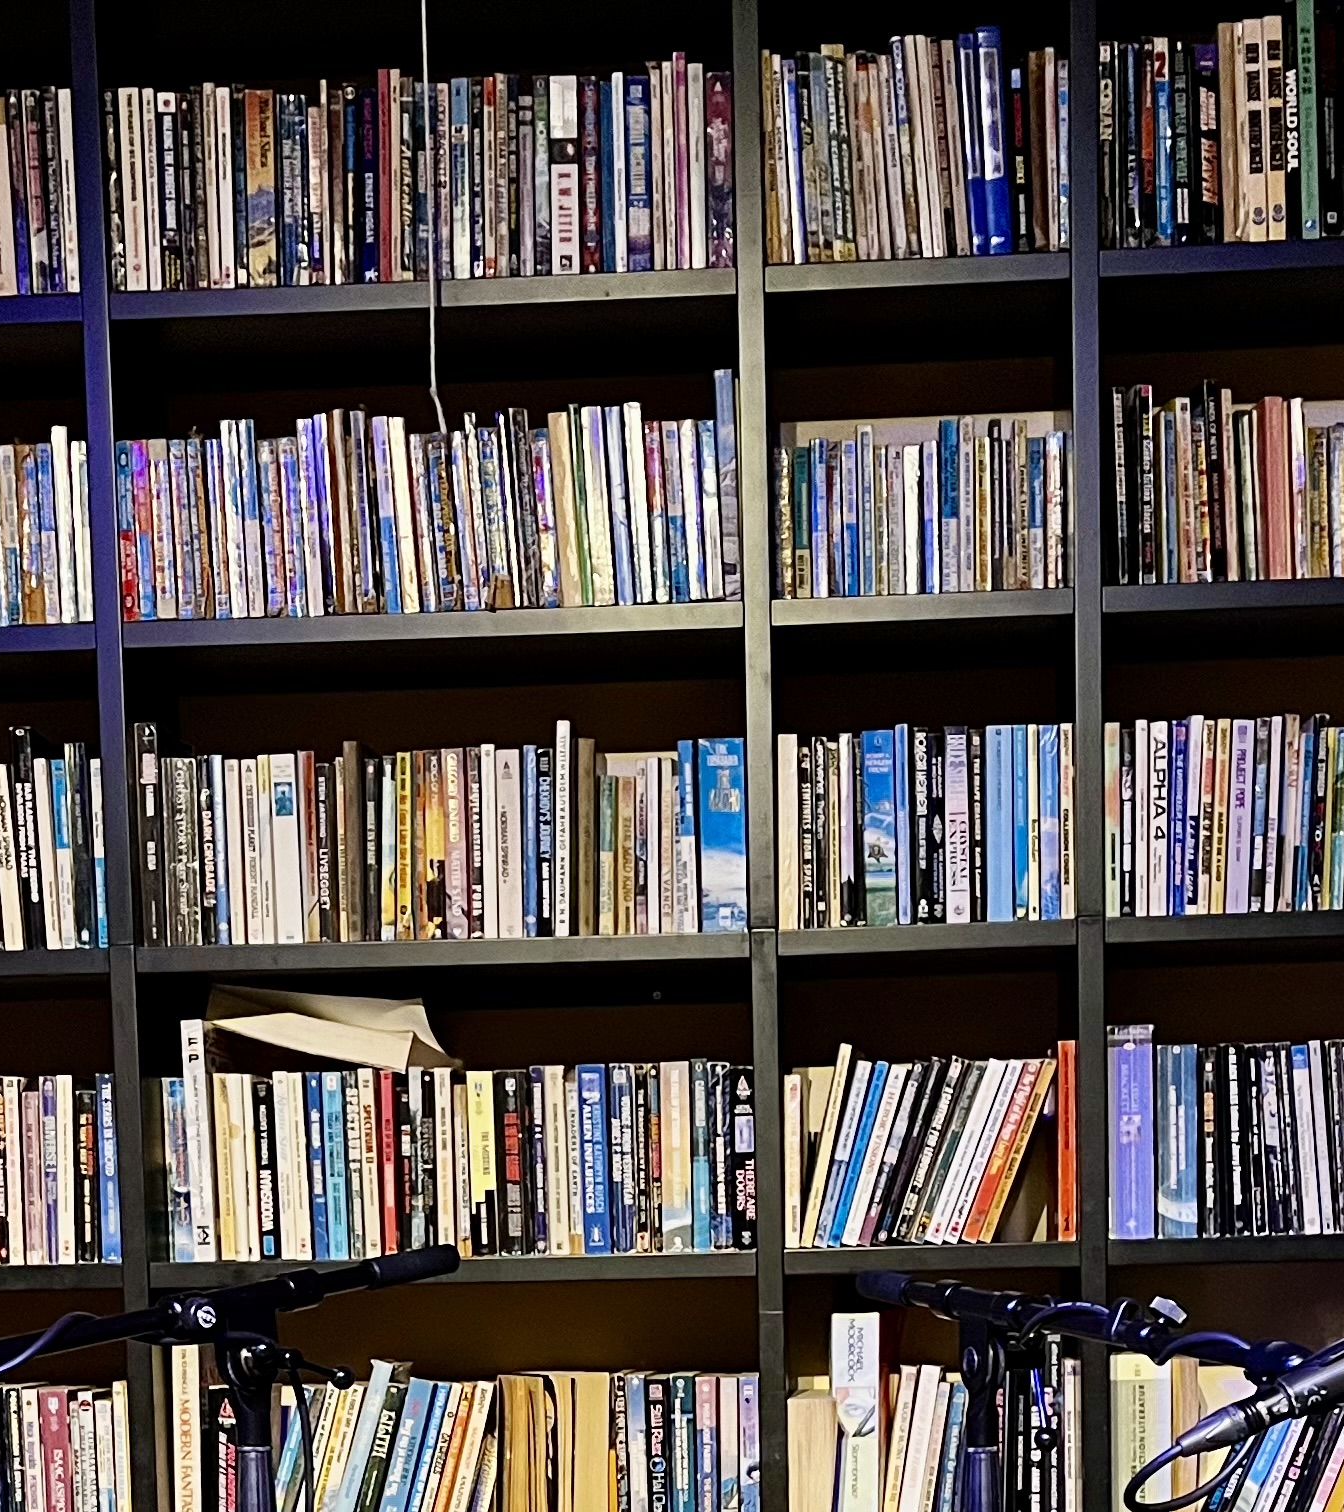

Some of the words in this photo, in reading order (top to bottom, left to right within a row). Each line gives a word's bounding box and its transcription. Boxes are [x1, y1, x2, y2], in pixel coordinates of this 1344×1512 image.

[1100, 79, 1113, 141] CONAN
[1285, 69, 1297, 129] WORLD
[1287, 131, 1299, 172] SOUL
[365, 172, 374, 208] ERNEST
[365, 211, 375, 244] HOGAN
[1208, 397, 1216, 425] LANDS
[1209, 425, 1216, 435] OF
[1210, 438, 1218, 461] NEVER
[1154, 737, 1165, 820] ALPHA
[1236, 749, 1246, 785] PROJECT
[175, 770, 185, 809] GHOST
[802, 783, 812, 831] SENTINELS
[1236, 787, 1246, 810] POPE
[0, 795, 10, 833] NORMAN
[177, 811, 187, 851] STORY
[203, 811, 214, 842] DARK
[623, 816, 632, 843] THE
[1063, 809, 1071, 850] COLLISION
[803, 834, 812, 859] FROM
[959, 821, 968, 882] CRYSTAL
[1154, 826, 1166, 841] 4
[3, 836, 13, 871] SPINRAD
[204, 843, 216, 892] CRUSADE
[623, 846, 633, 871] MAD
[950, 819, 959, 888] EXPRESS
[319, 849, 330, 910] LIVSEGGET
[624, 873, 633, 903] KING
[803, 863, 813, 892] SPACE
[179, 883, 190, 915] Straub
[364, 1105, 374, 1153] SPECTRUM
[584, 1105, 593, 1141] ALIEN
[593, 1105, 603, 1142] KRISTINE
[880, 1091, 895, 1131] HEROIC
[571, 1153, 578, 1165] OF
[594, 1145, 604, 1182] KATHRYN
[866, 1134, 882, 1176] VISIONS
[585, 1143, 594, 1214] INFLUENCES
[736, 1170, 746, 1211] DOORS
[745, 1159, 755, 1195] THERE
[595, 1185, 604, 1214] RUSCH
[746, 1196, 755, 1221] ARE
[848, 1318, 856, 1382] MOORCOCK
[856, 1327, 864, 1372] MICHAEL
[180, 1399, 194, 1460] MODERN
[651, 1404, 663, 1427] Still
[651, 1429, 663, 1457] River
[54, 1449, 64, 1482] ISAAC
[653, 1473, 665, 1492] Hal
